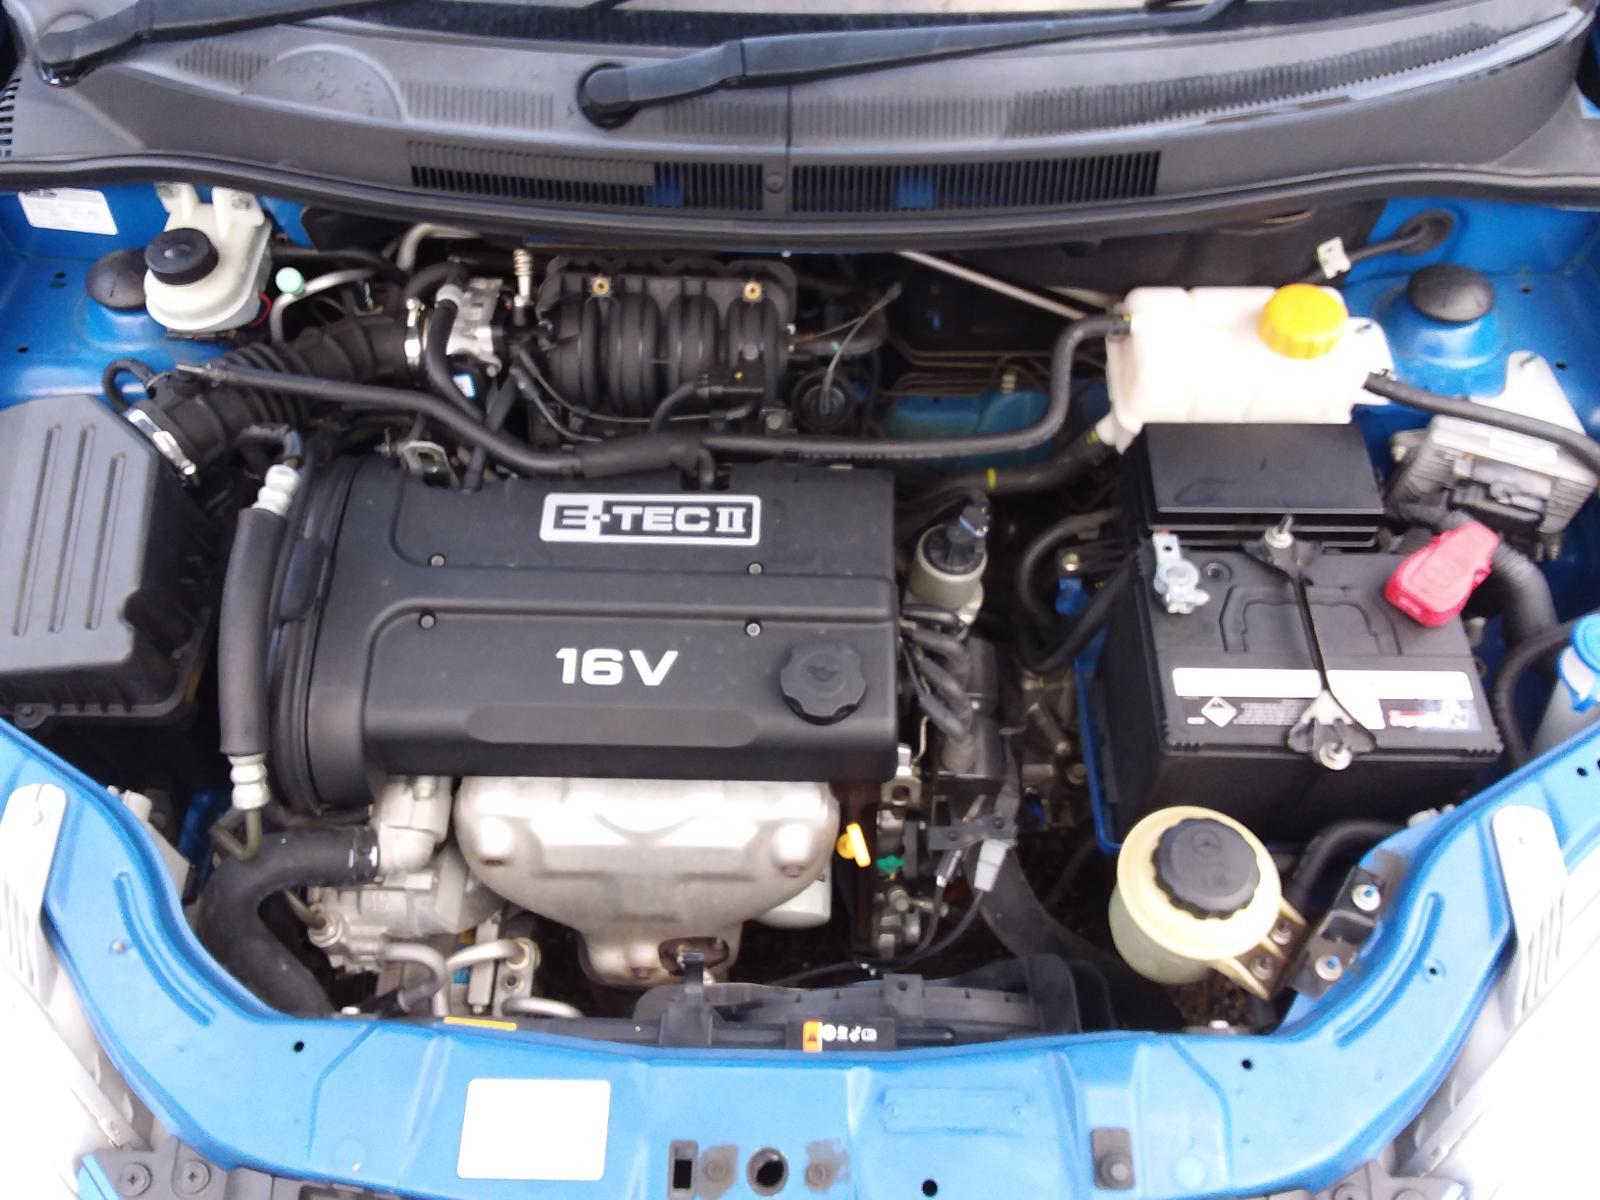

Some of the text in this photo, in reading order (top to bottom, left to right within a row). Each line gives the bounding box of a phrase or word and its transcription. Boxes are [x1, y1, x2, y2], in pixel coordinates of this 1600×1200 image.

[553, 505, 747, 533] E-TEC II
[555, 648, 679, 686] 16V
